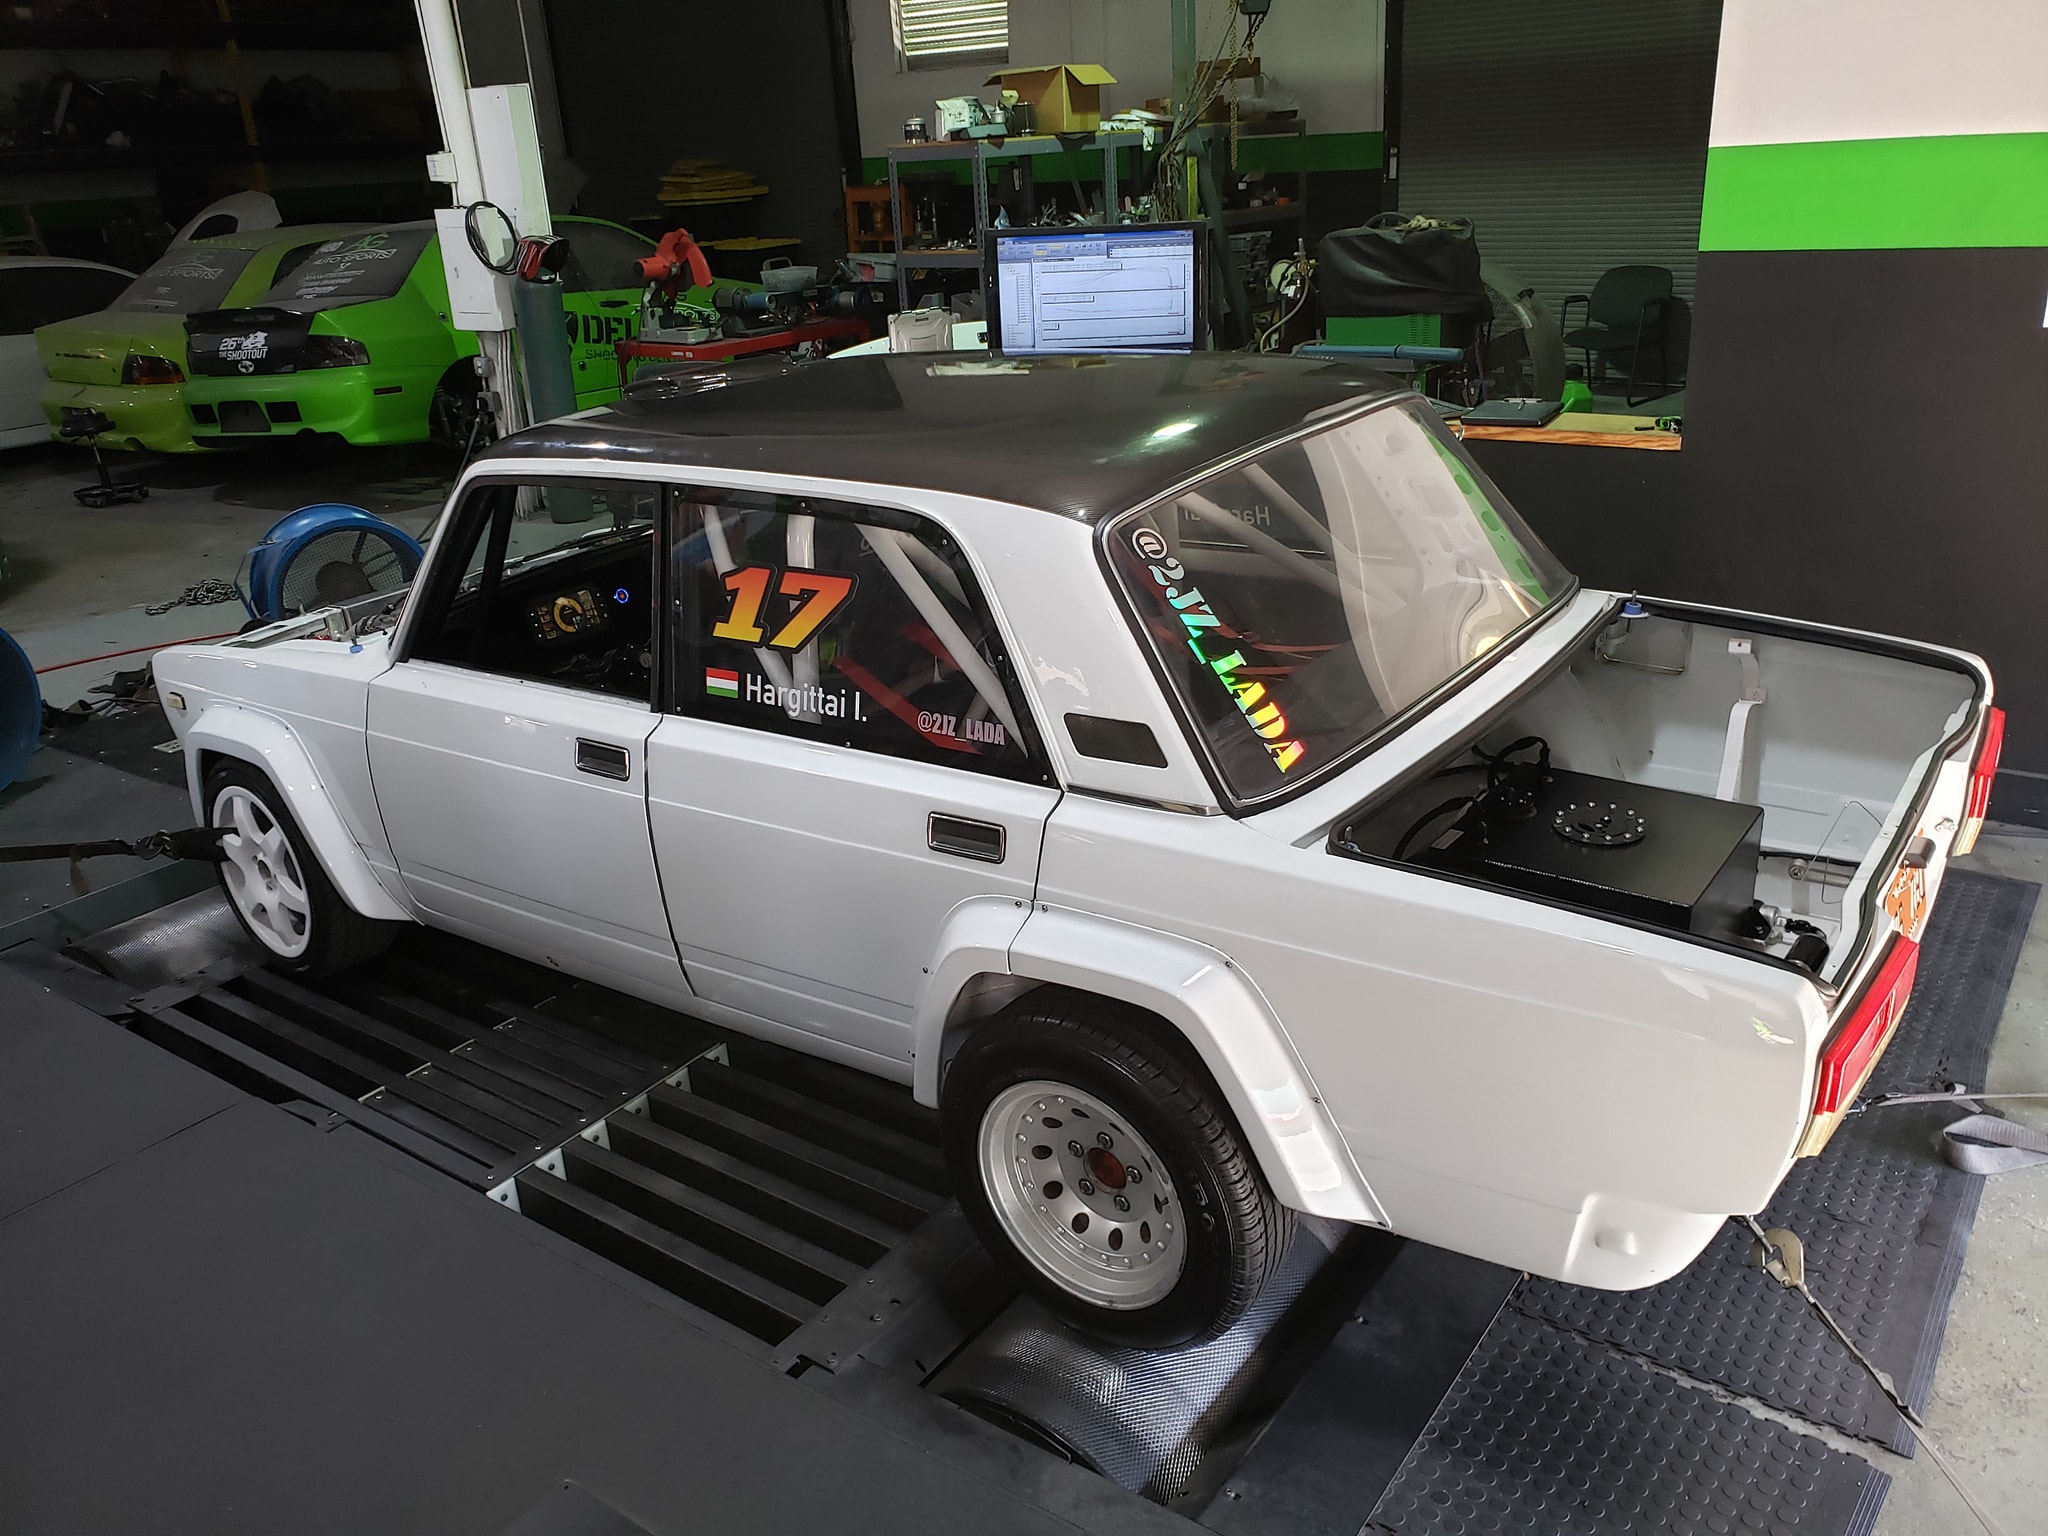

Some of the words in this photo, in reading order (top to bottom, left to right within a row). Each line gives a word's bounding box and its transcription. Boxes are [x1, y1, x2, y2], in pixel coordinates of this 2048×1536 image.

[227, 348, 268, 361] SHOOTOUT
[711, 566, 853, 649] 17
[1131, 527, 1305, 774] @2JZ_LADA
[746, 673, 846, 717] Hargittai
[917, 710, 1006, 746] @2JZ_LADA
